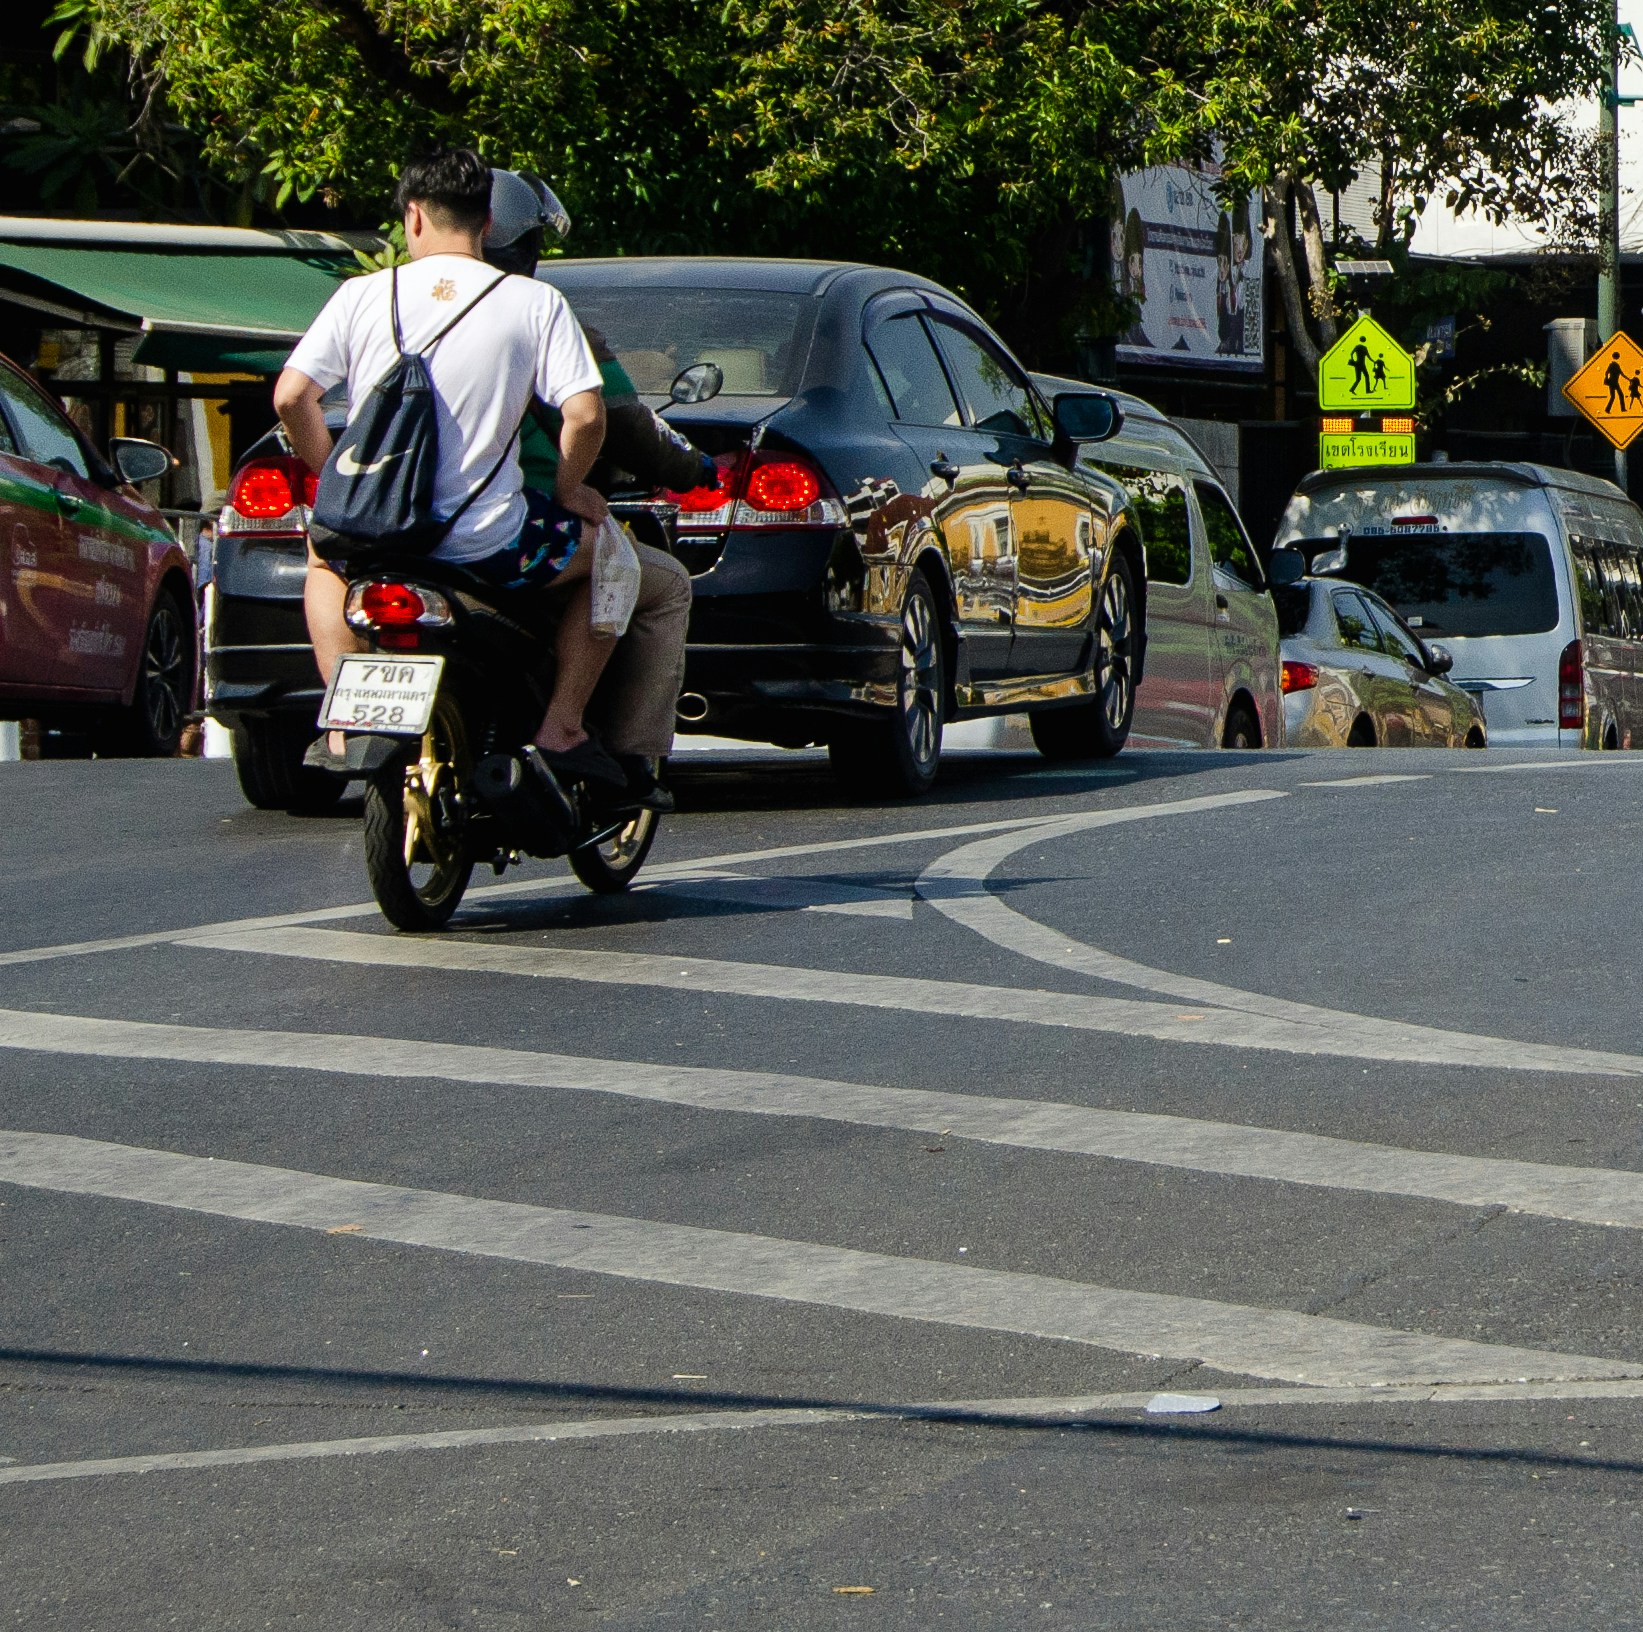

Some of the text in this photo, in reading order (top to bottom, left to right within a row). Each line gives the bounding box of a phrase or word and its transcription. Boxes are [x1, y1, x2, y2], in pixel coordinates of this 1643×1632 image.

[1325, 436, 1409, 458] เขตโรงเรียน
[334, 688, 427, 702] กรุงเทพมหานคร
[352, 705, 404, 723] 528
